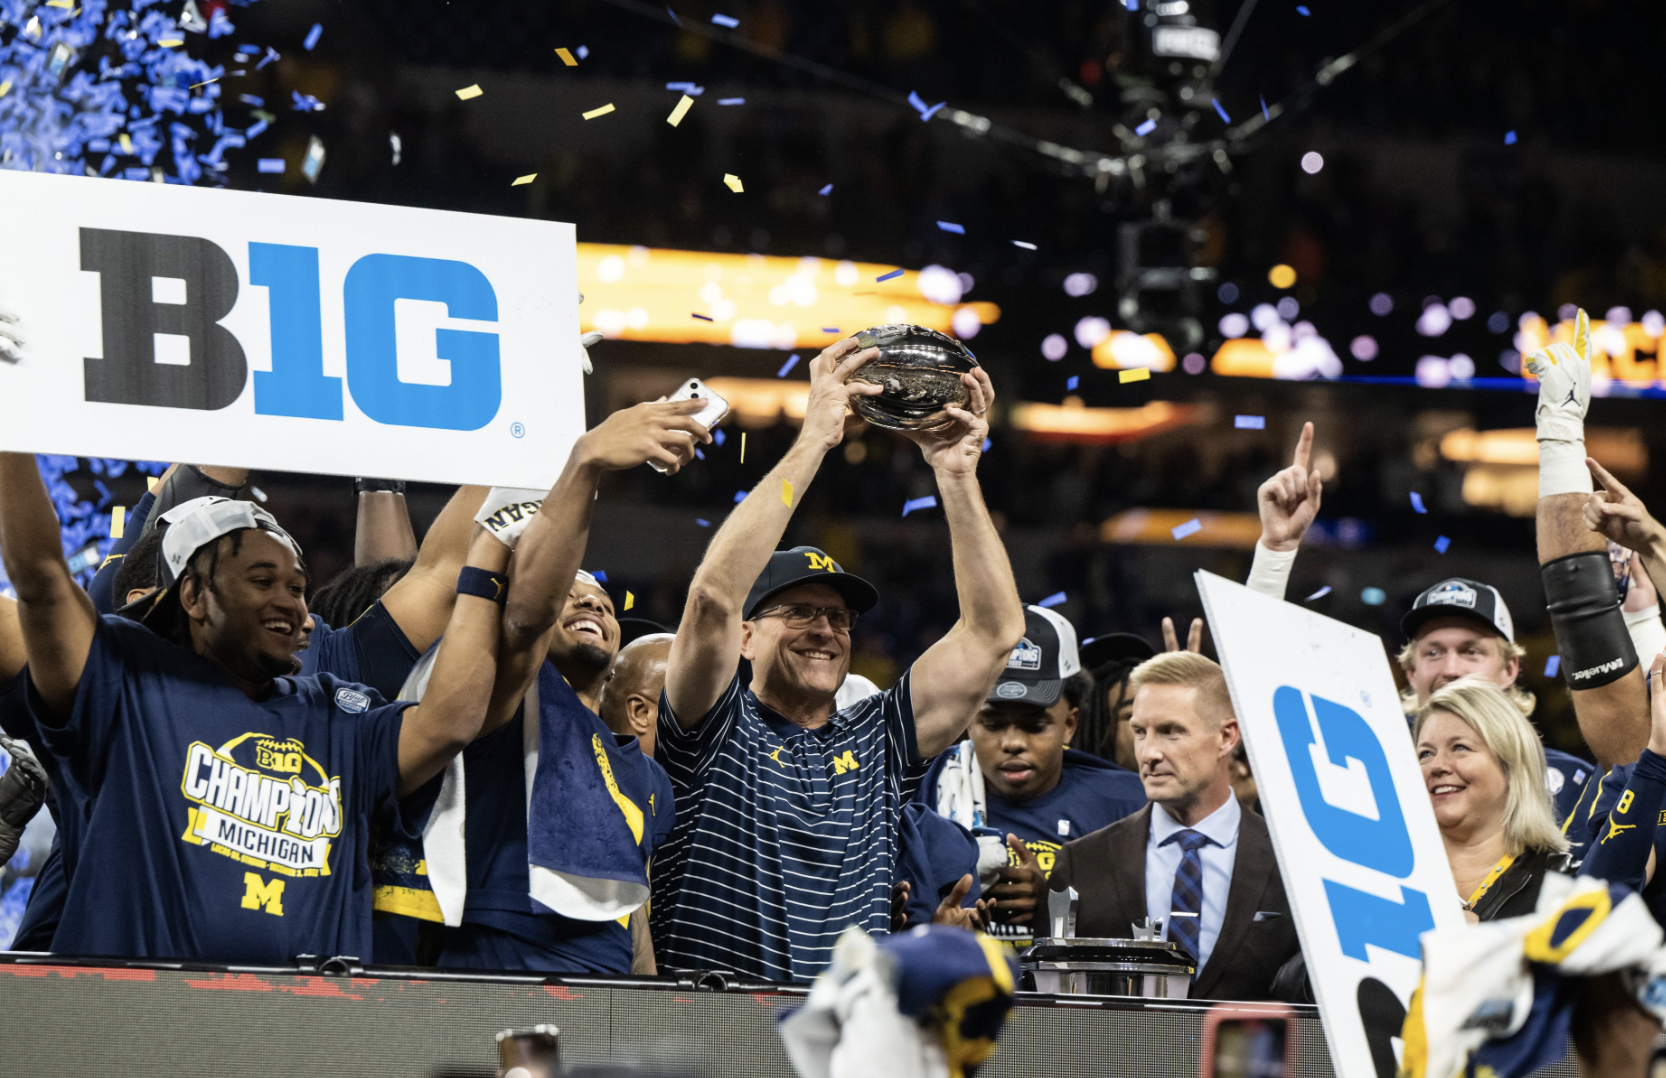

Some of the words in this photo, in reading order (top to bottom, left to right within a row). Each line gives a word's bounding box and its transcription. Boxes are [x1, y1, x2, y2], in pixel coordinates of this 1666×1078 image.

[804, 552, 836, 573] M
[833, 750, 860, 775] M
[184, 743, 341, 839] CHAMPIONS
[1617, 789, 1635, 814] 8
[218, 819, 314, 864] MICHIGAN
[241, 871, 286, 916] M
